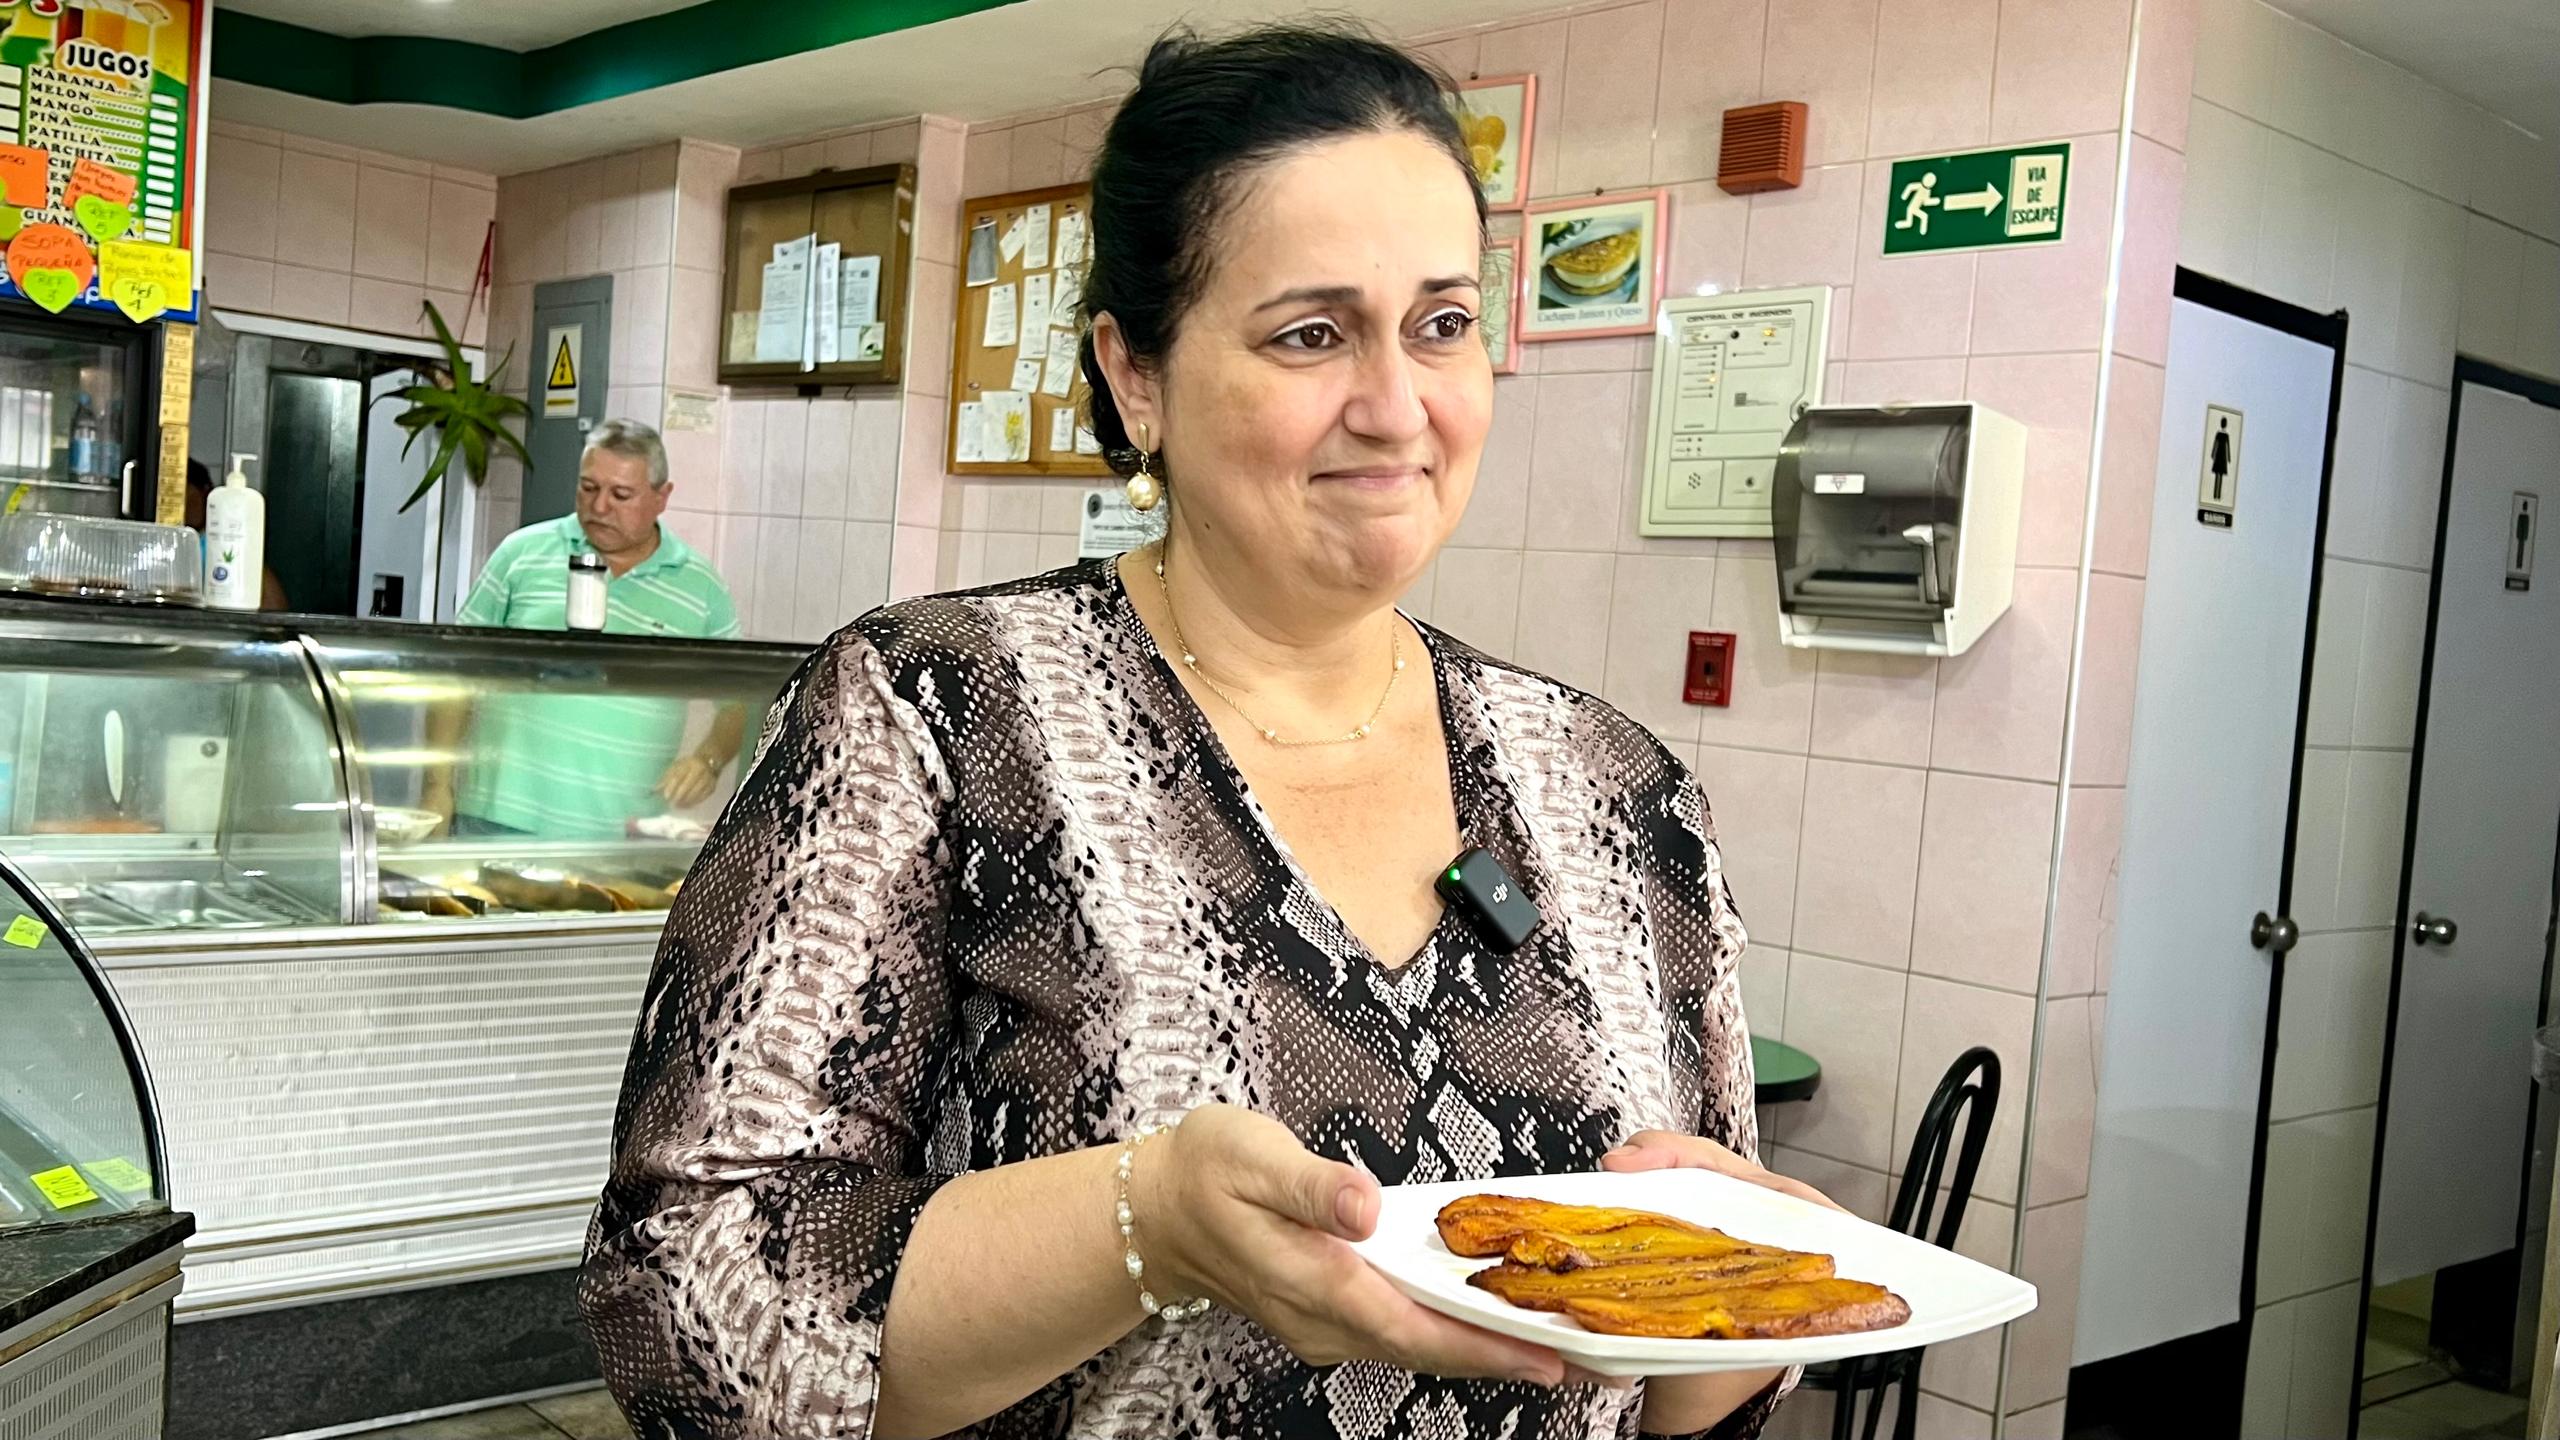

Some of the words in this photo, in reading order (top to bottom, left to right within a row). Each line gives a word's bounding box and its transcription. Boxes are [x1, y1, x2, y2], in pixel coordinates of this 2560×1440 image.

[67, 44, 149, 78] JUGOS
[31, 67, 116, 92] NARANJA
[30, 82, 90, 101] MELON
[29, 96, 94, 116] MANGO
[29, 110, 72, 127] PIÑA
[28, 124, 101, 146] PATILLA
[27, 139, 116, 164] PARCHITA
[2028, 167, 2046, 182] VIA
[2027, 188, 2042, 203] DE
[2011, 206, 2058, 225] ESCAPE
[1687, 314, 1726, 323] CENTRAL
[1749, 309, 1792, 318] INCENDIO
